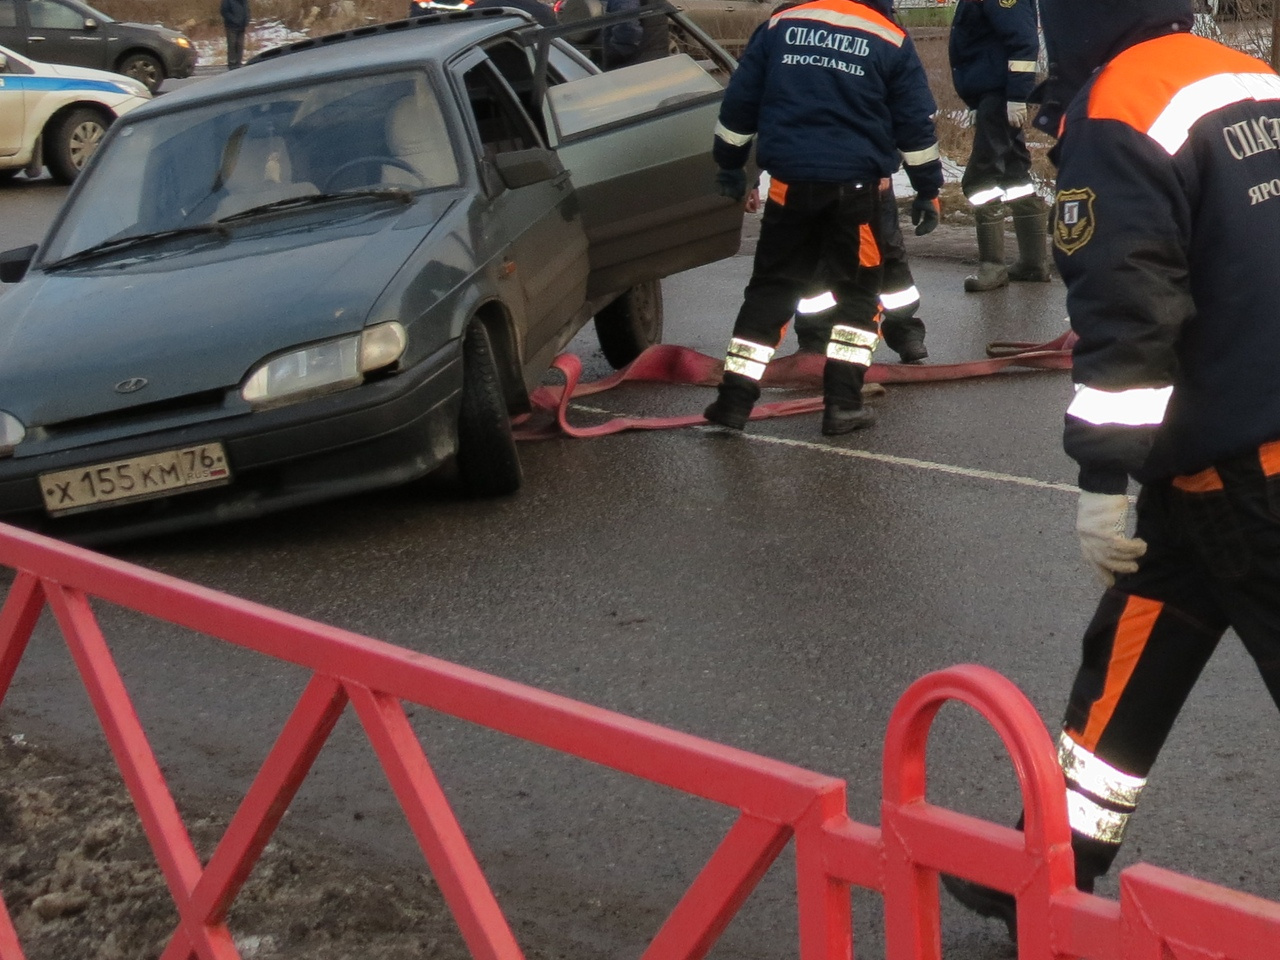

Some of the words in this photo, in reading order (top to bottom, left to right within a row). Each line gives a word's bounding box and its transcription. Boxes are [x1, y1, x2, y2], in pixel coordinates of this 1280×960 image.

[785, 26, 870, 57] СПАСАТЕЛЬ
[781, 54, 865, 76] ЯРОСЛАВЛЬ
[183, 447, 214, 472] 76
[187, 470, 209, 481] RUS
